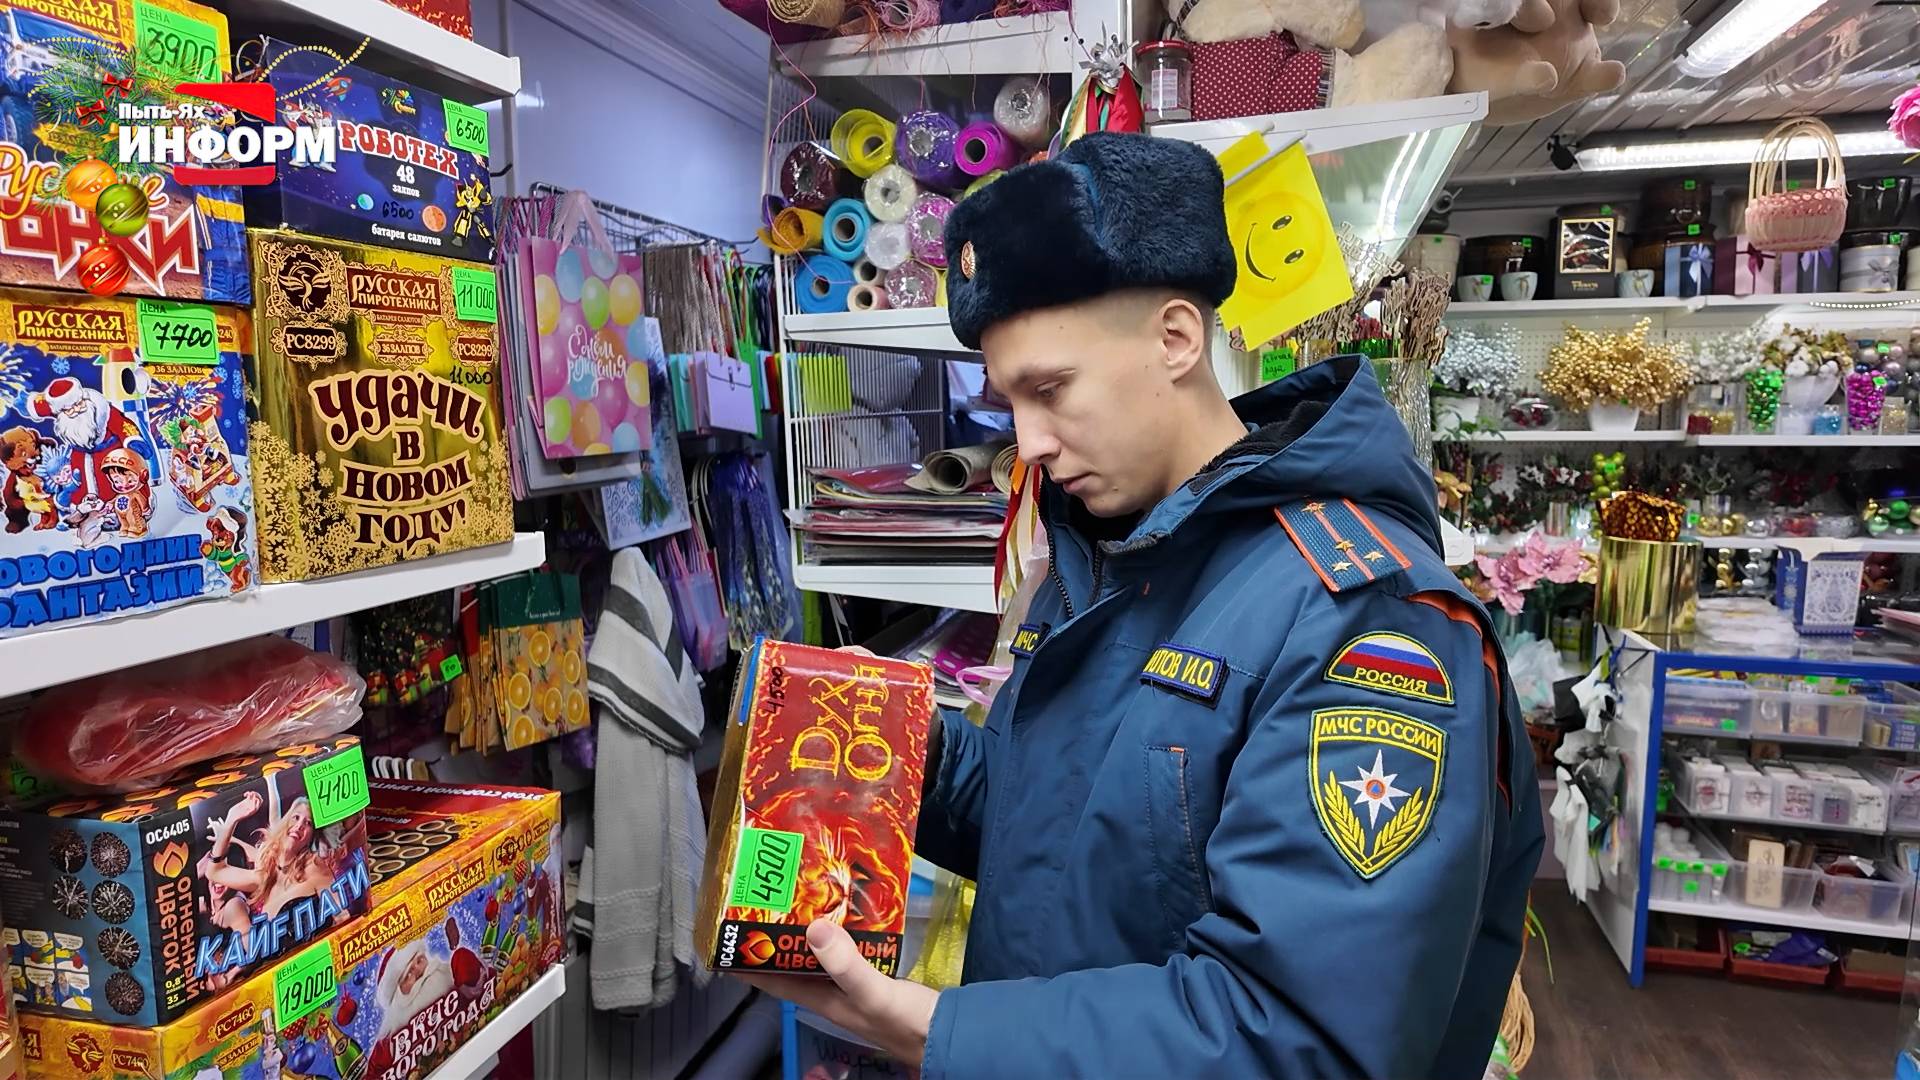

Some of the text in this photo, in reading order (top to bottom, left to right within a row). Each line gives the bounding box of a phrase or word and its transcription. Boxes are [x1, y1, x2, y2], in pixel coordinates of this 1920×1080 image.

[140, 6, 170, 24] ЦЕНА
[148, 27, 216, 80] 3900
[446, 103, 463, 113] ЦЕНА
[456, 118, 485, 144] 6500
[337, 120, 460, 179] РОБОТЕХ
[396, 165, 415, 184] 48
[392, 184, 420, 197] залпов
[382, 202, 414, 220] 6500
[408, 233, 442, 246] салютов
[352, 273, 437, 301] РУССКАЯ
[140, 303, 167, 314] ЦЕНА
[358, 294, 440, 311] ПИРОТЕХНИКА
[18, 309, 122, 335] РУССКАЯ
[26, 326, 126, 341] ПИРОТЕХНИКА
[153, 322, 213, 350] 7700
[286, 334, 337, 350] РС8299
[381, 343, 390, 353] 36
[156, 365, 203, 374] 36 ЗАЛПОВ
[341, 457, 472, 501] НОВОМ
[355, 498, 467, 548] ГОДУ!
[0, 534, 203, 588] ОВОГОДНИЕ
[1013, 630, 1039, 652] МЧС
[1181, 655, 1214, 690] И.О.
[1354, 667, 1428, 695] РОССИЯ
[766, 666, 785, 714] 4500
[1320, 716, 1438, 753] МЧС РОССИИ
[310, 764, 334, 778] ЦЕНА
[318, 770, 359, 806] 4100
[146, 819, 190, 845] ОС6405
[751, 833, 791, 902] 4500
[429, 861, 482, 911] РУССКАЯ
[435, 872, 485, 909] ПИРОТЕХНИКА
[733, 874, 748, 903] ЦЕНА
[344, 907, 408, 966] РУССКАЯ
[349, 919, 411, 962] ПИРОТЕХНИКА
[719, 924, 739, 967] ОС6432
[277, 965, 299, 981] ЦЕНА
[166, 994, 179, 1005] 35
